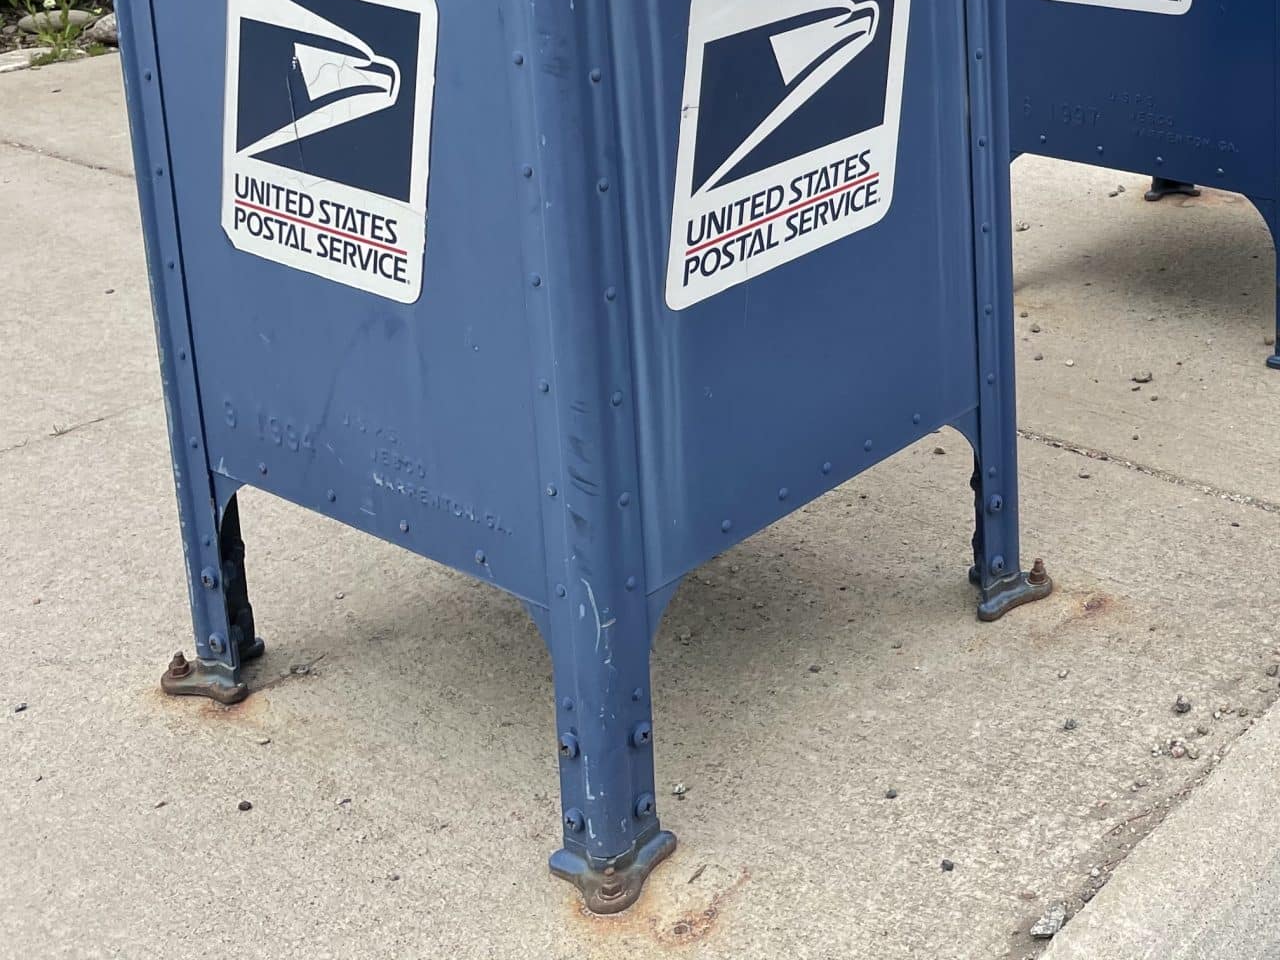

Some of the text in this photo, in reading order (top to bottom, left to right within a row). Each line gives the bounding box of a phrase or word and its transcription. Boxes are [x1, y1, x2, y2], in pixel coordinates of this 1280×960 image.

[234, 173, 398, 245] UNITED STATES
[683, 179, 880, 287] POSTAL SERVICE
[686, 149, 871, 247] UNITED STATES
[234, 206, 408, 285] POSTAL SERVICE
